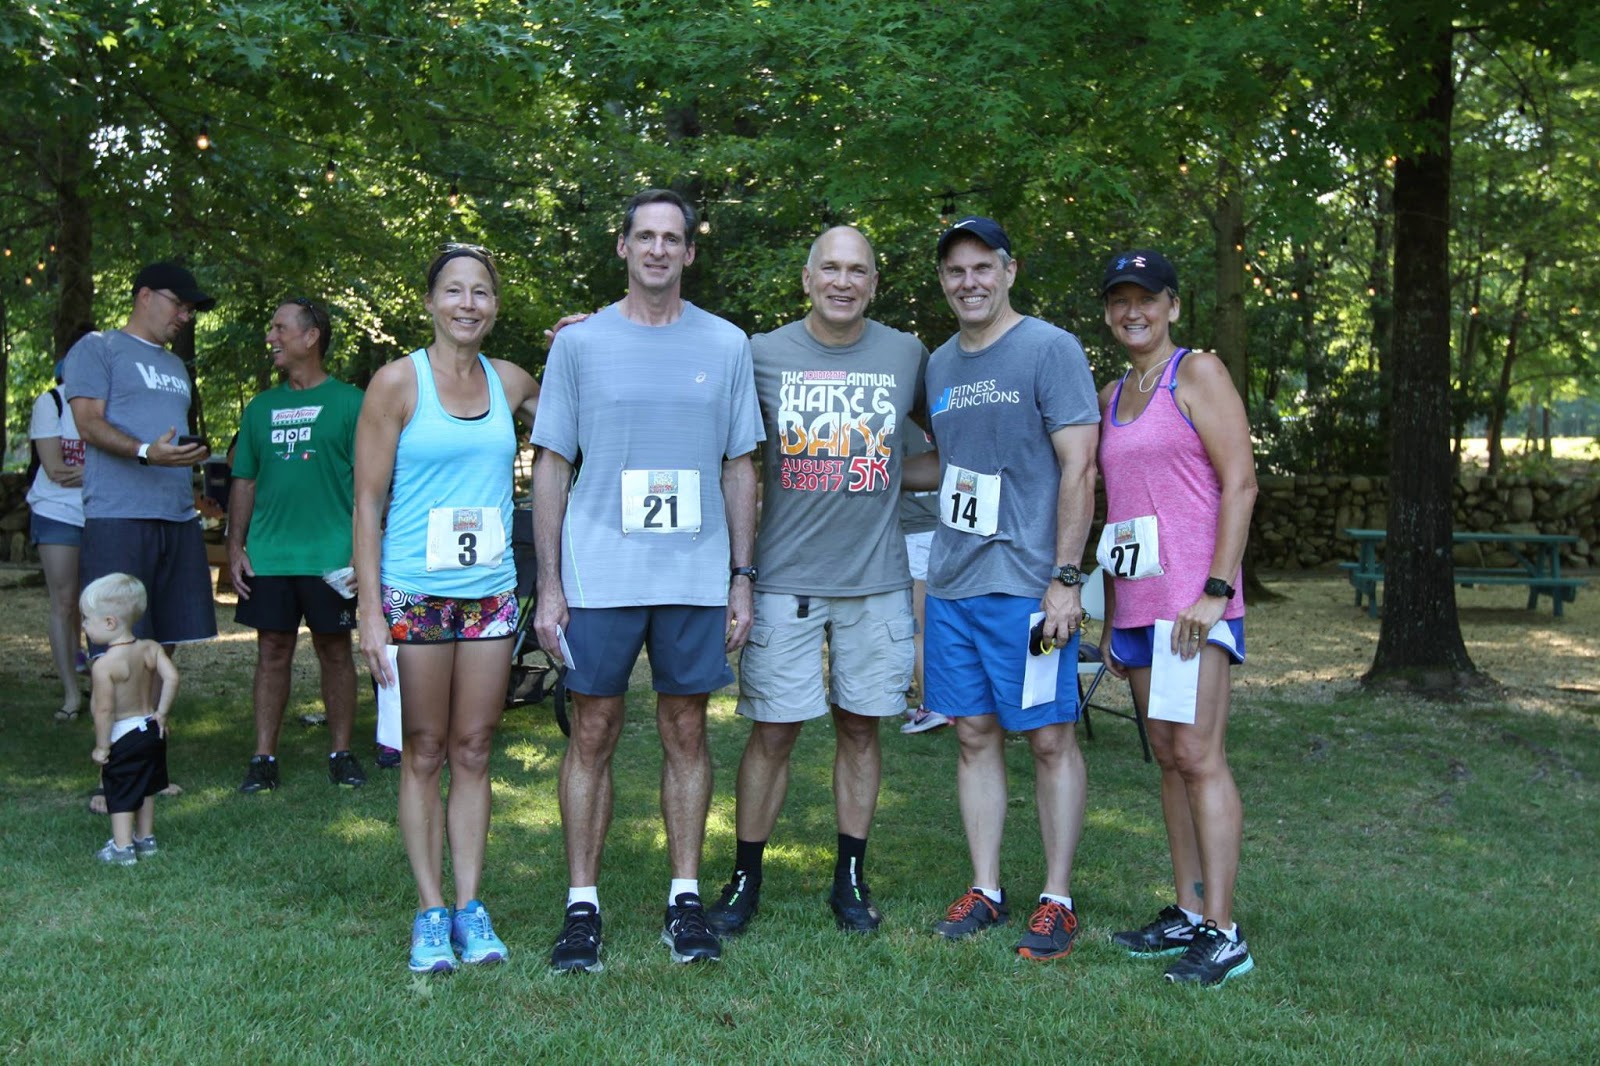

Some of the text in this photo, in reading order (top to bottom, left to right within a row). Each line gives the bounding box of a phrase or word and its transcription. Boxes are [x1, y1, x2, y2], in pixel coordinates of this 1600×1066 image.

[780, 371, 804, 385] THE
[846, 372, 897, 388] ANNUAL
[952, 379, 996, 398] FITNESS
[779, 384, 865, 414] SHAKE
[949, 390, 1020, 410] FUNCTIONS
[778, 410, 897, 458] BAKE
[780, 456, 891, 492] AUGUST 5K
[643, 494, 678, 529] 21
[951, 492, 977, 529] 14
[458, 532, 478, 567] 3
[1110, 543, 1140, 577] 27
